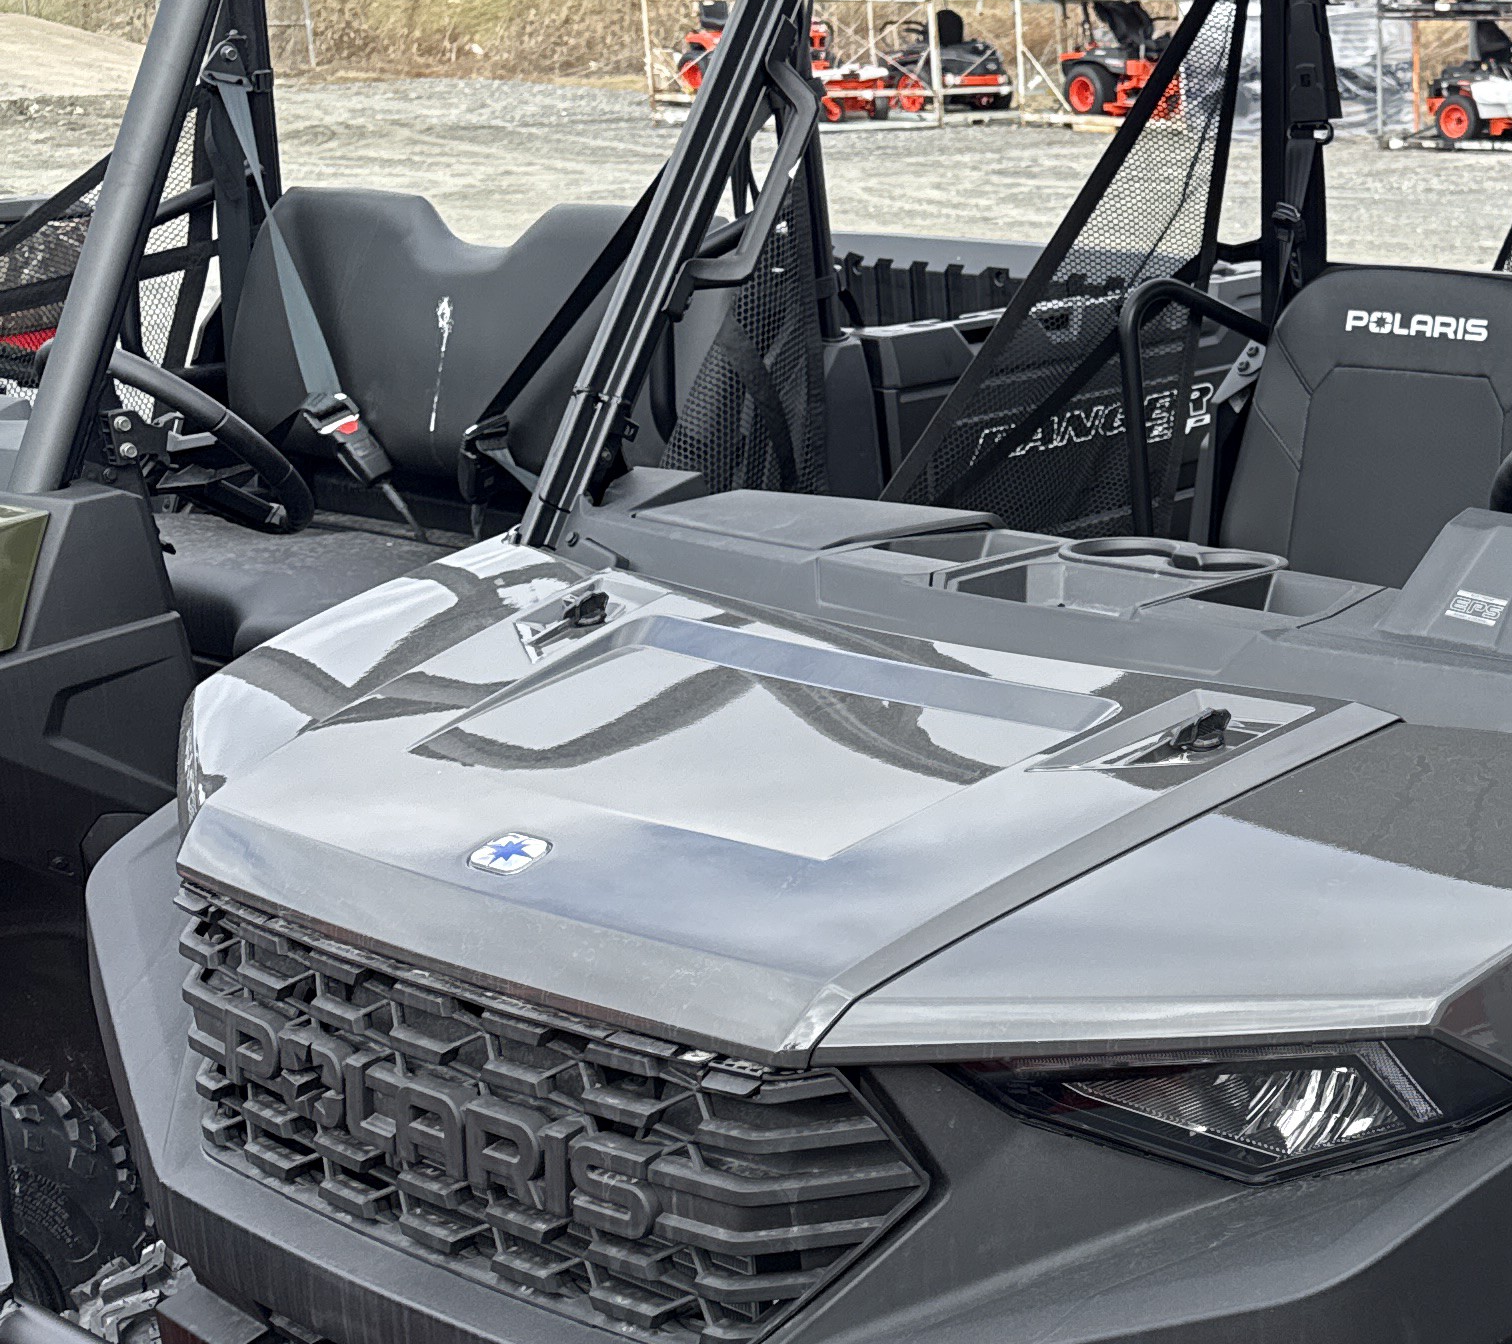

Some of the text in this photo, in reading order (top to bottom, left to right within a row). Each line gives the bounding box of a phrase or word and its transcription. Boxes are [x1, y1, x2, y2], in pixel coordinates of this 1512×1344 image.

[1345, 309, 1489, 342] POLARIS
[1449, 596, 1505, 620] EPS
[224, 994, 664, 1241] POLARIS
